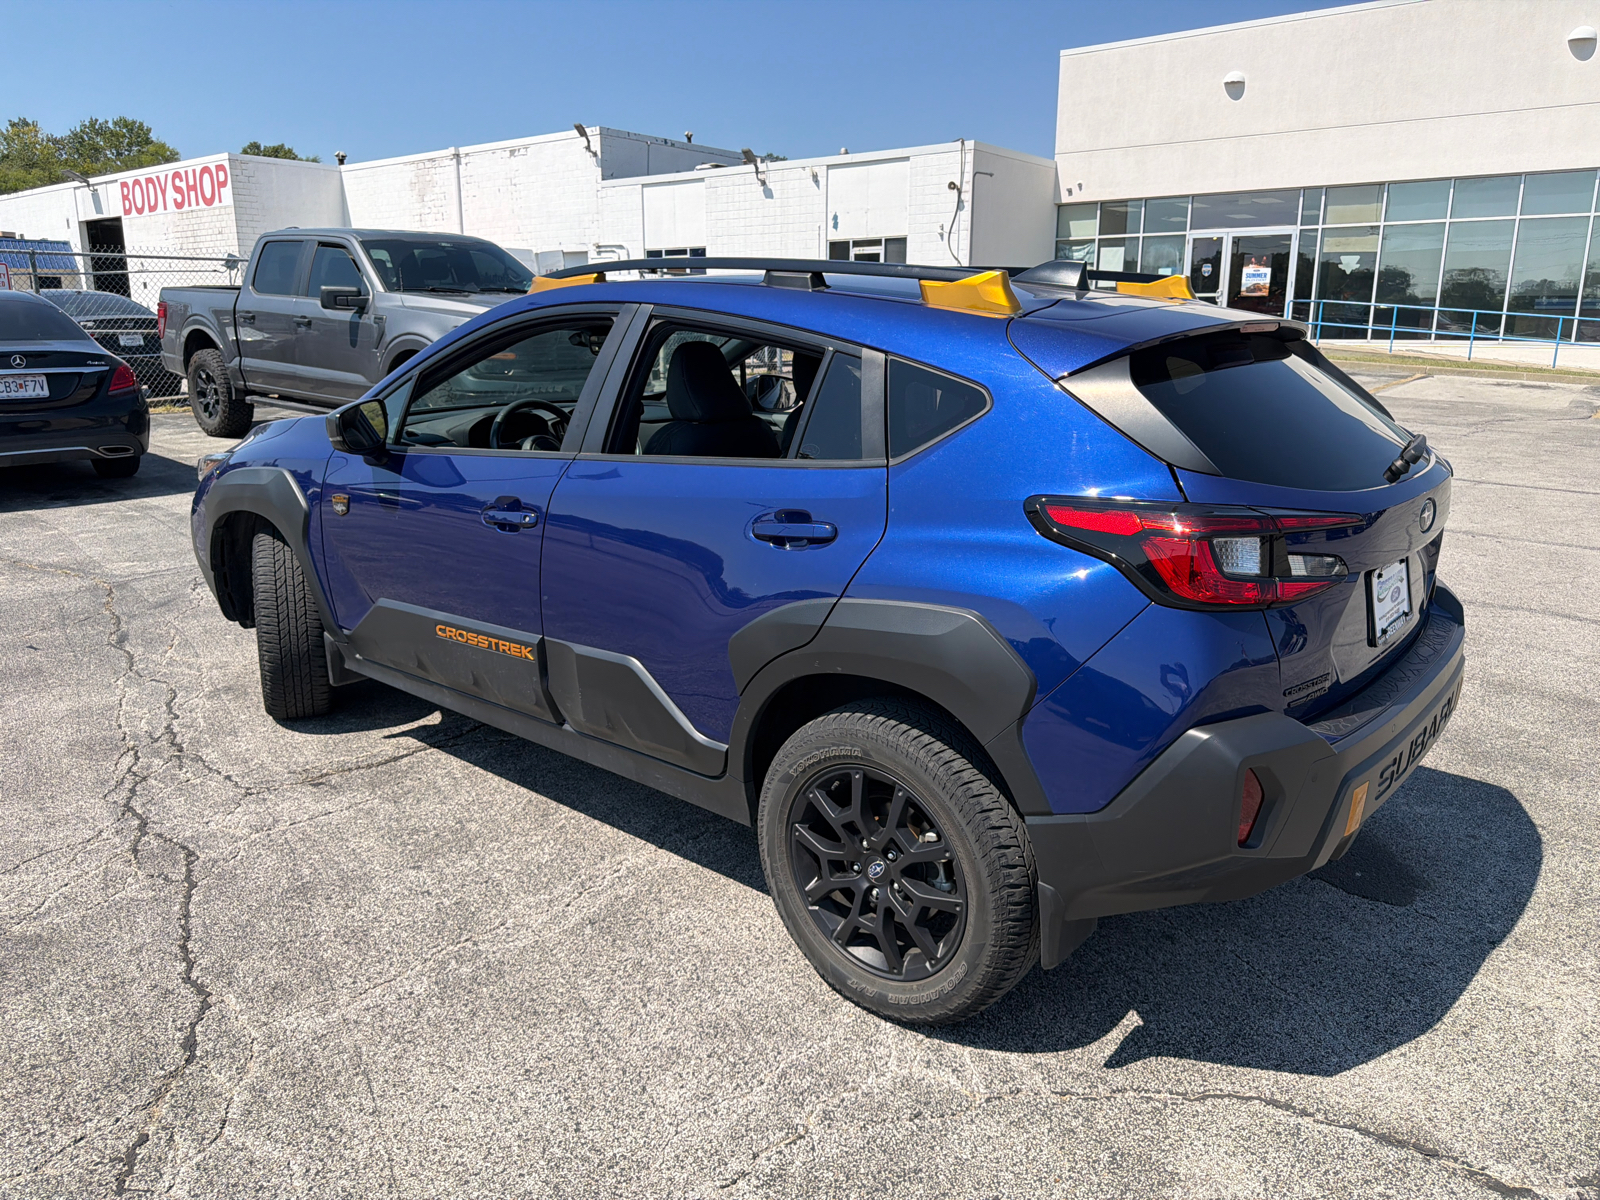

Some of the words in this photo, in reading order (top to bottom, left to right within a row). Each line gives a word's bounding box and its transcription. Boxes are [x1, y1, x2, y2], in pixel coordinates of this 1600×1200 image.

[120, 173, 168, 216] BODY
[171, 164, 228, 210] SHOP
[435, 624, 534, 661] CROSSTREK
[789, 746, 863, 777] YOKOHAMA
[1375, 682, 1460, 801] SUBARU
[888, 961, 968, 1005] GEOLANDAR
